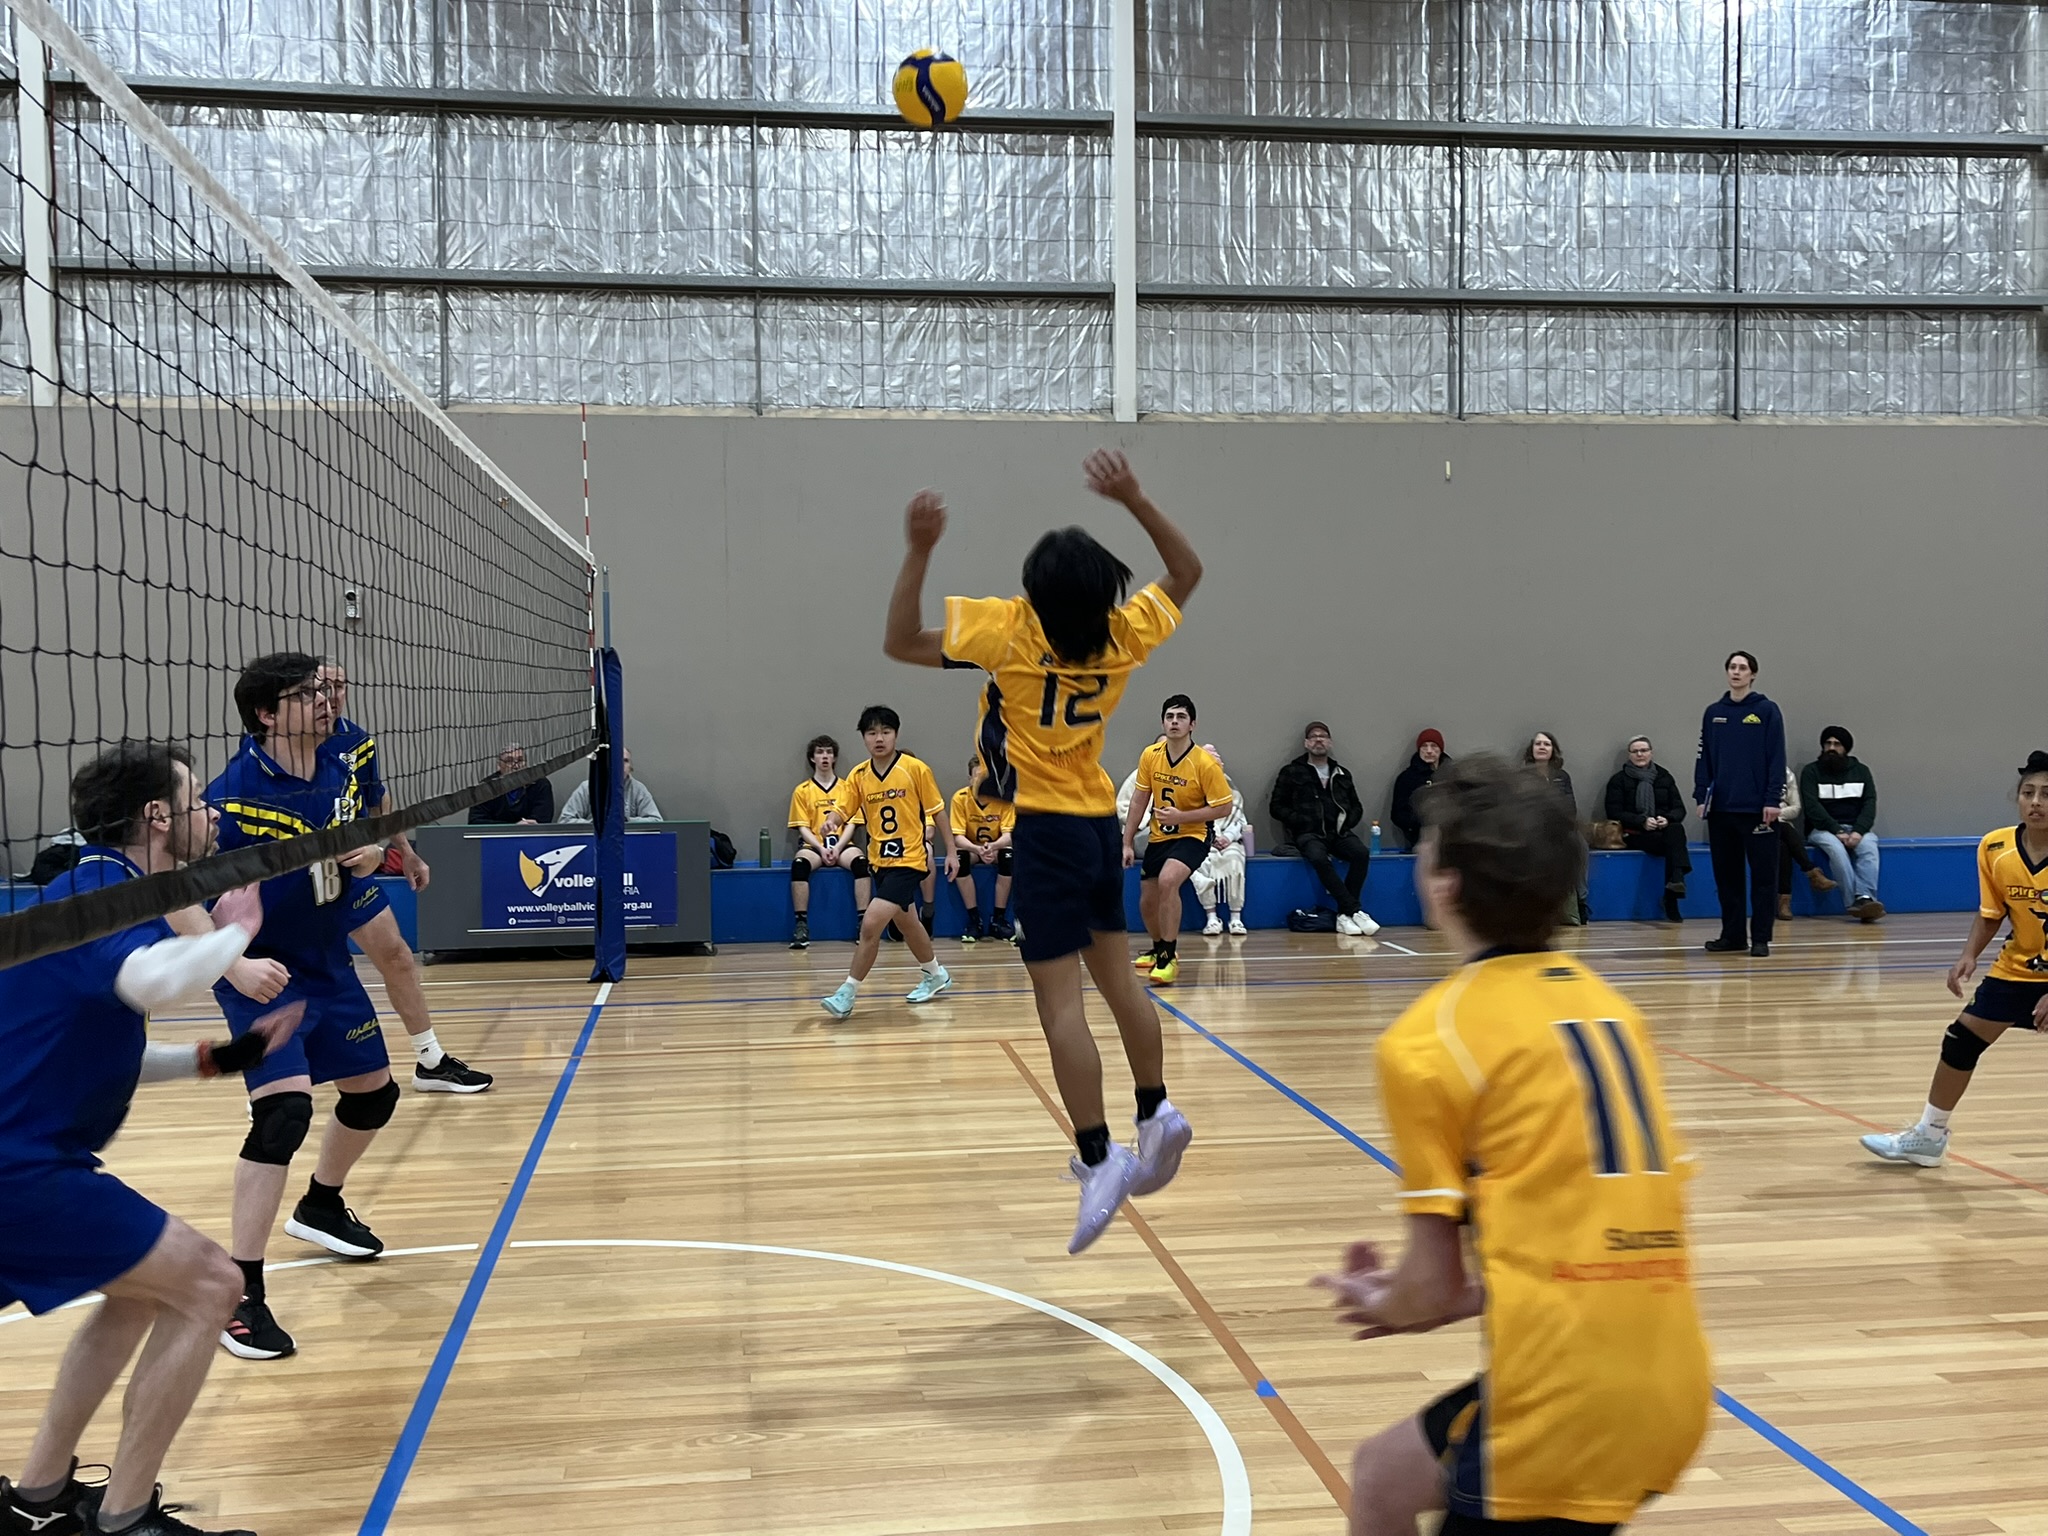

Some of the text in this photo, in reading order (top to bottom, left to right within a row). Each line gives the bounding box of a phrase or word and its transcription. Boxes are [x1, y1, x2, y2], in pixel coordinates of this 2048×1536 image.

[1038, 669, 1108, 730] 12
[1161, 787, 1176, 809] 5
[880, 805, 898, 835] 8
[976, 826, 993, 845] 6
[309, 858, 342, 906] 18
[1550, 1018, 1671, 1178] 11
